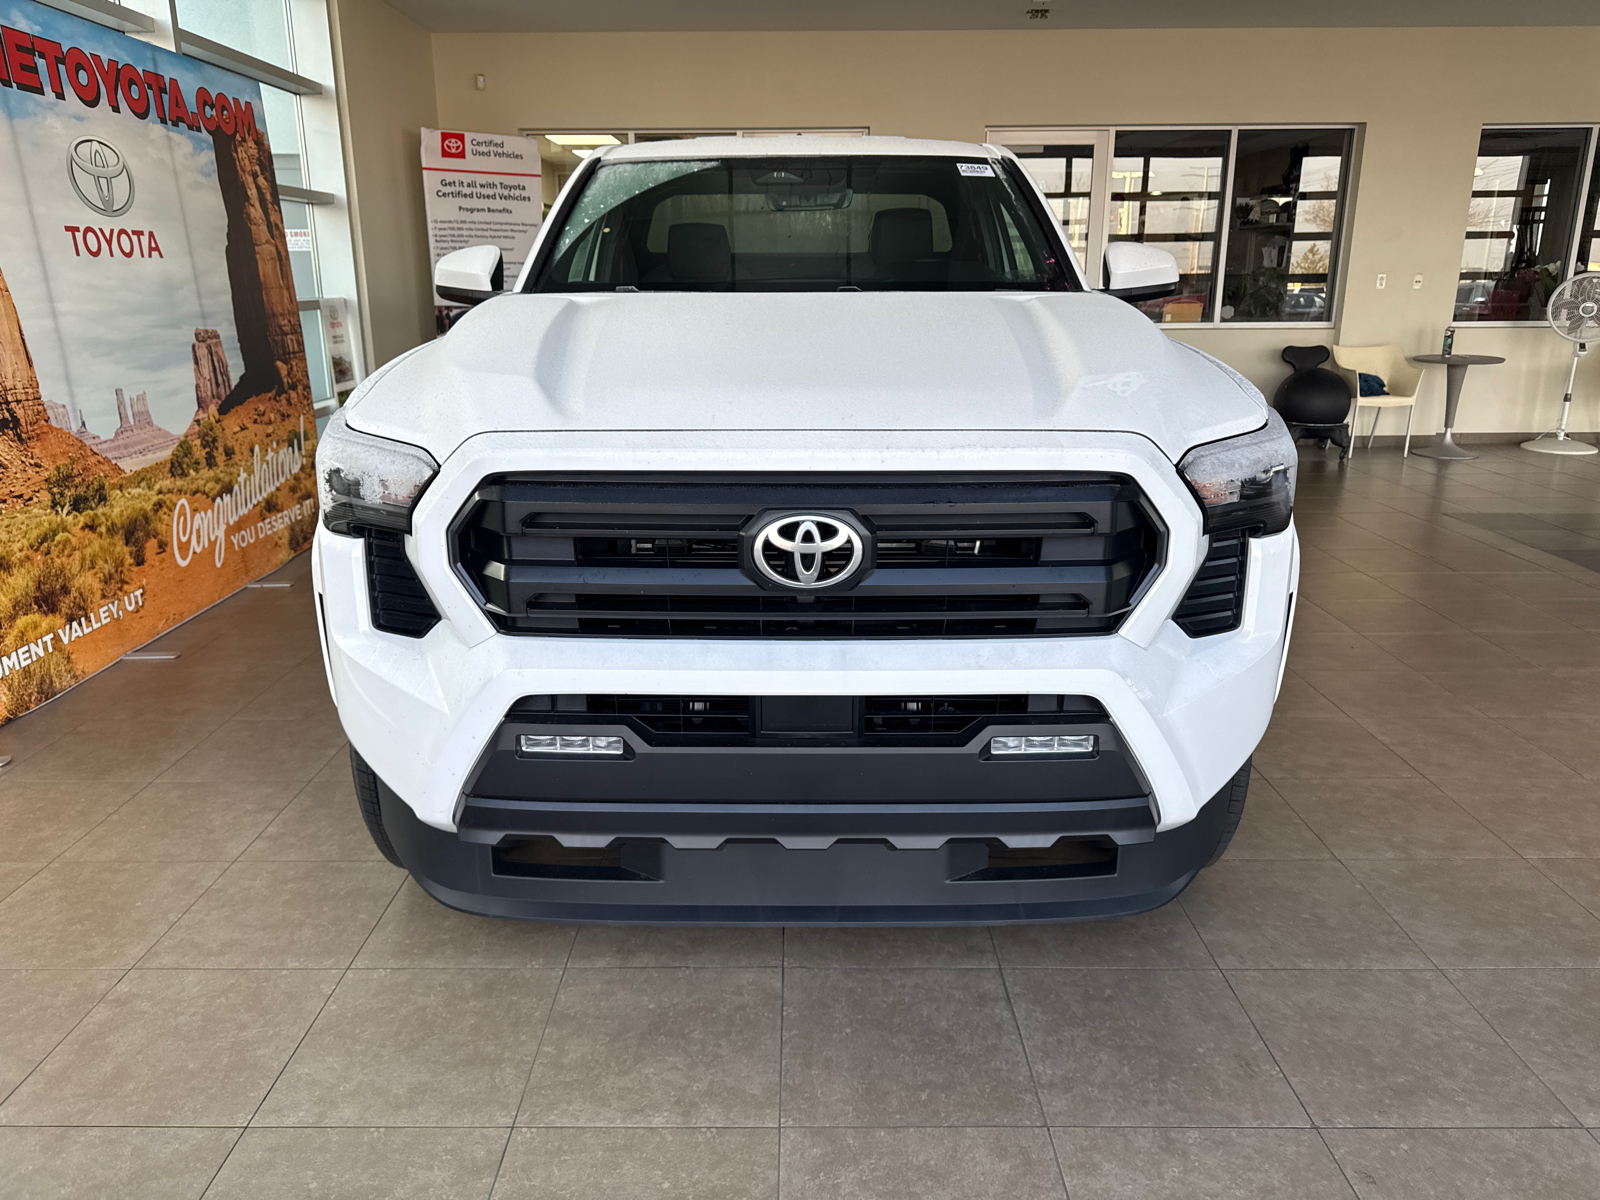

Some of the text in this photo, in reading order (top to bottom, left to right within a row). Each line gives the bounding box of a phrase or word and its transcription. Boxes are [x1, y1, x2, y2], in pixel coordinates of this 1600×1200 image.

[471, 138, 504, 149] Certified
[471, 148, 524, 160] Used Vehicles
[440, 178, 526, 191] Get it all with Toyota
[436, 189, 531, 202] Certified Used Vehicles
[458, 205, 486, 214] Program
[64, 225, 164, 259] TOYOTA
[173, 414, 307, 568] Congratulations!
[231, 498, 316, 551] YOU DESERVE IT!
[57, 600, 124, 646] VALLEY,
[124, 588, 144, 612] UT
